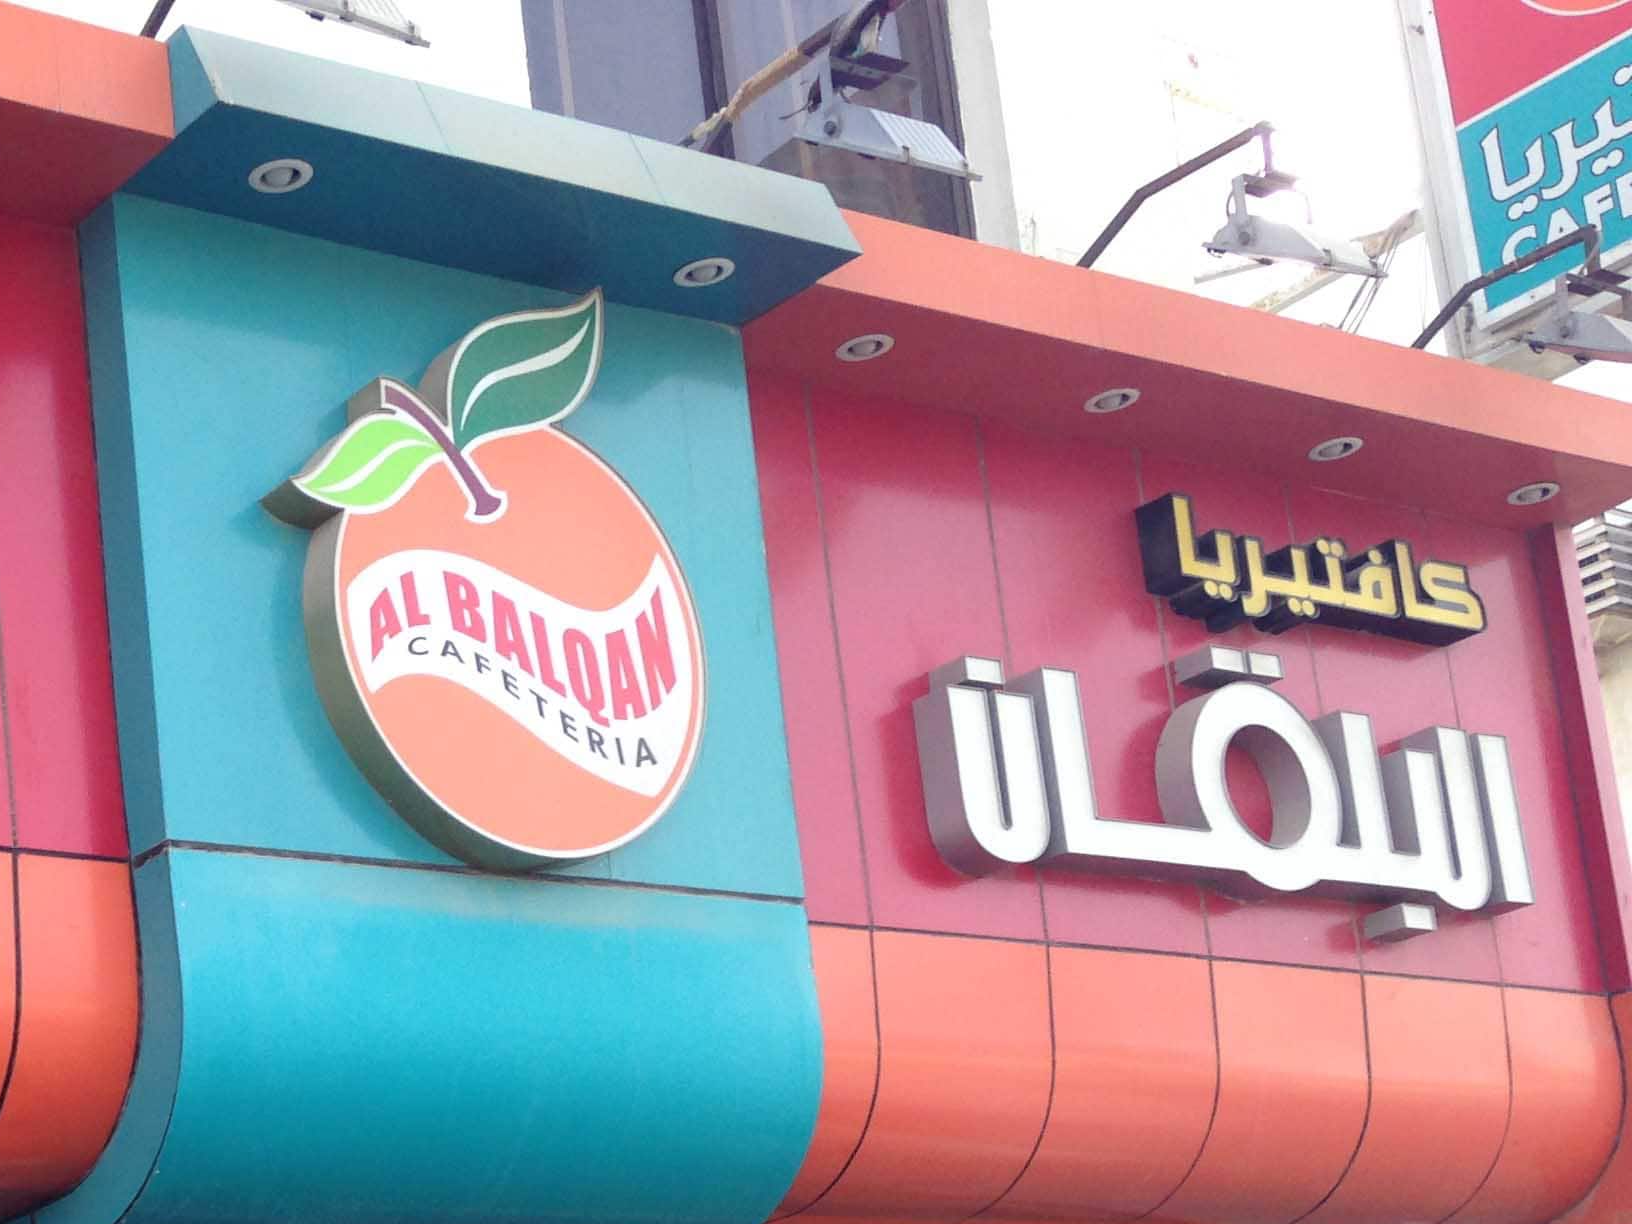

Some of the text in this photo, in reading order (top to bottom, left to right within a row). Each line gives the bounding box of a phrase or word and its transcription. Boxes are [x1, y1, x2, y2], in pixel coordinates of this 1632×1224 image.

[1170, 494, 1485, 631] كافتيريا
[369, 570, 676, 728] AL BALQAN
[408, 636, 658, 768] CAFETERIA
[945, 645, 1534, 932] البلقان
